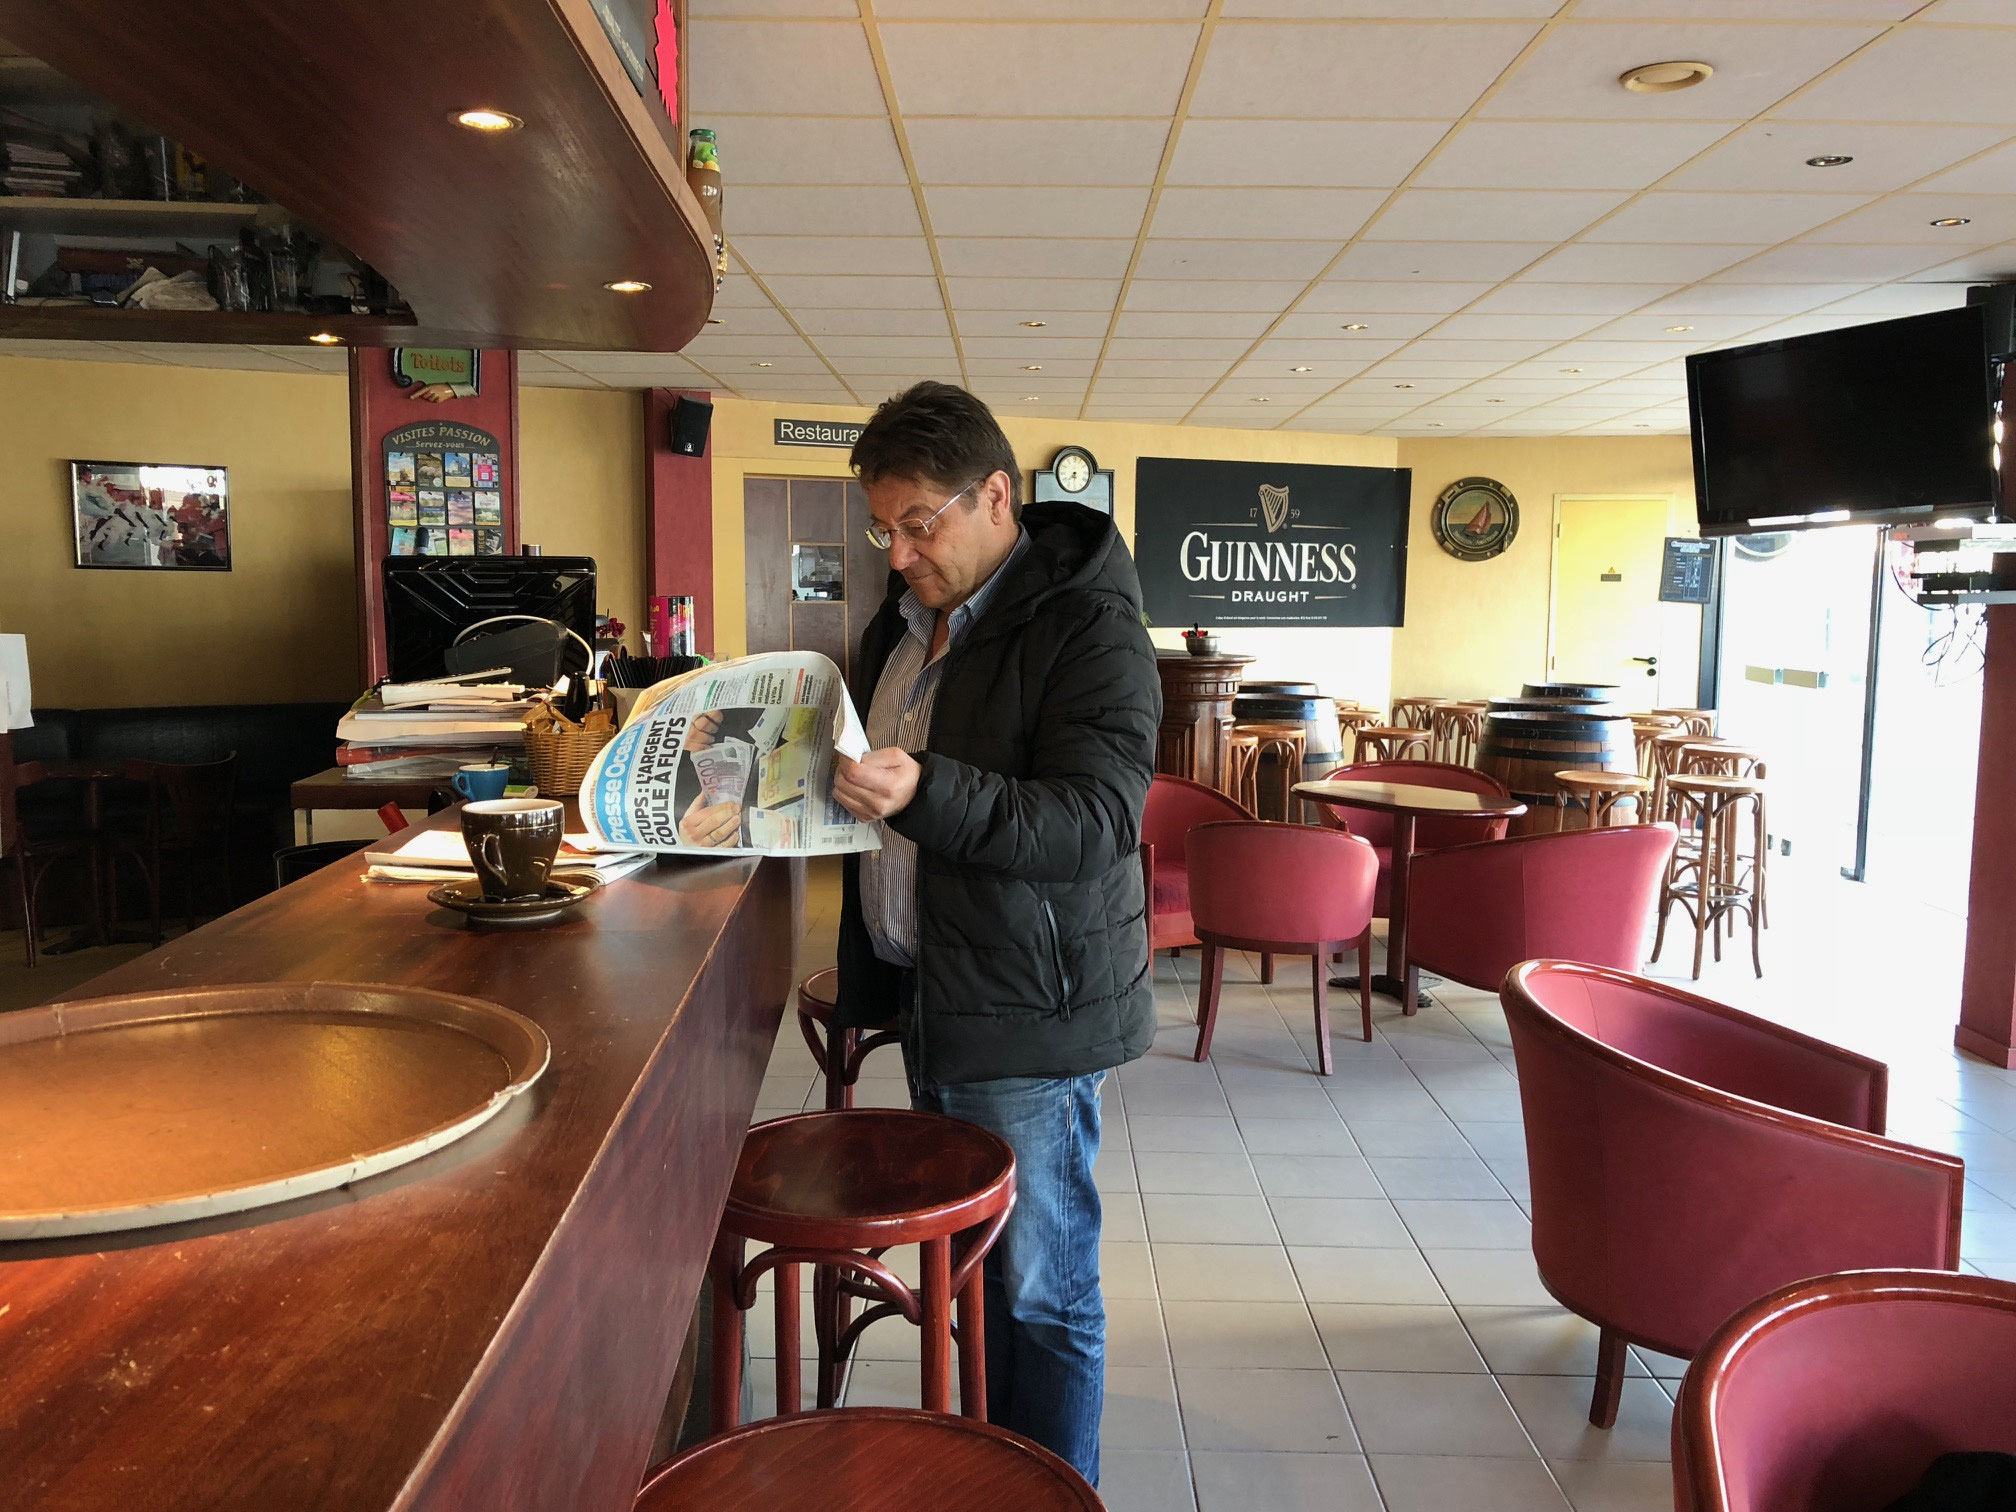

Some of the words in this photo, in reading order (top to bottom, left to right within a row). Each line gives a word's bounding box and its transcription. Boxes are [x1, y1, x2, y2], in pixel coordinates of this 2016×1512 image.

[392, 426, 435, 445] VISITES
[438, 426, 491, 447] PASSION
[415, 441, 465, 449] Servez-vous
[780, 422, 864, 442] Restaura
[1250, 507, 1257, 518] 17
[1290, 508, 1300, 518] 59
[1180, 531, 1357, 583] GUINNESS
[1231, 590, 1310, 603] DRAUGHT
[636, 720, 667, 785] L'ARGENT
[657, 717, 687, 768] FLOTS
[697, 758, 719, 789] 500
[633, 797, 660, 845] STUPS
[652, 789, 677, 845] COULE
